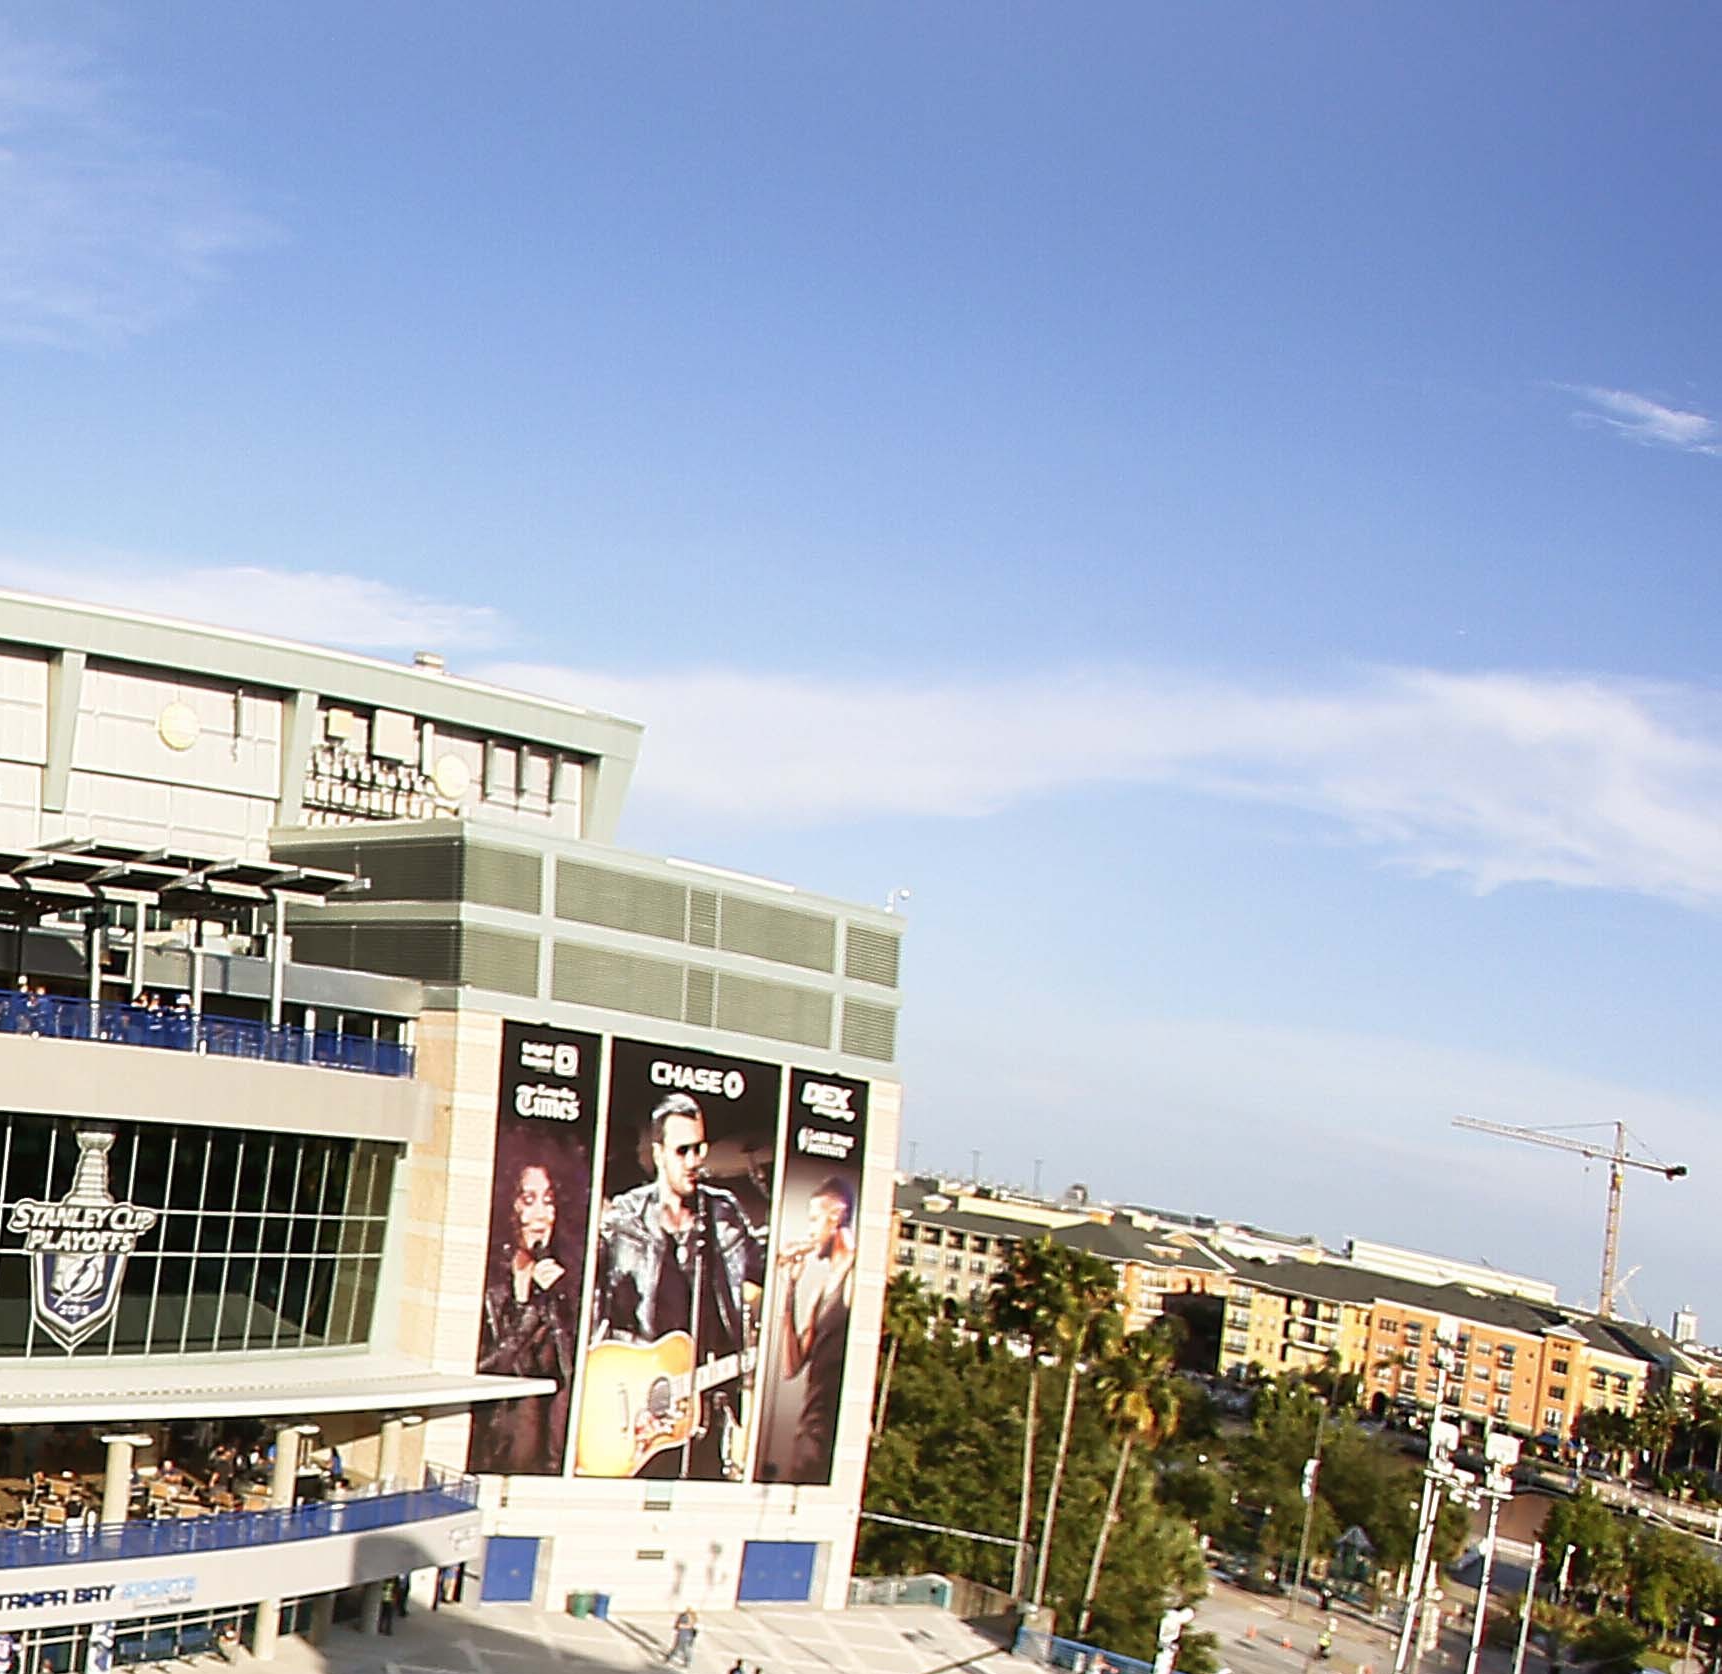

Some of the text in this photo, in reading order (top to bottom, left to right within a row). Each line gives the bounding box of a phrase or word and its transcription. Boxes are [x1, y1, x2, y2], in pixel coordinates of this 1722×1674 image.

[650, 1061, 724, 1094] CHASE
[801, 1082, 853, 1110] DEX
[12, 1204, 157, 1231] STANLEY CUP
[27, 1229, 137, 1252] PLAYOFFS
[72, 1584, 116, 1604] BAY
